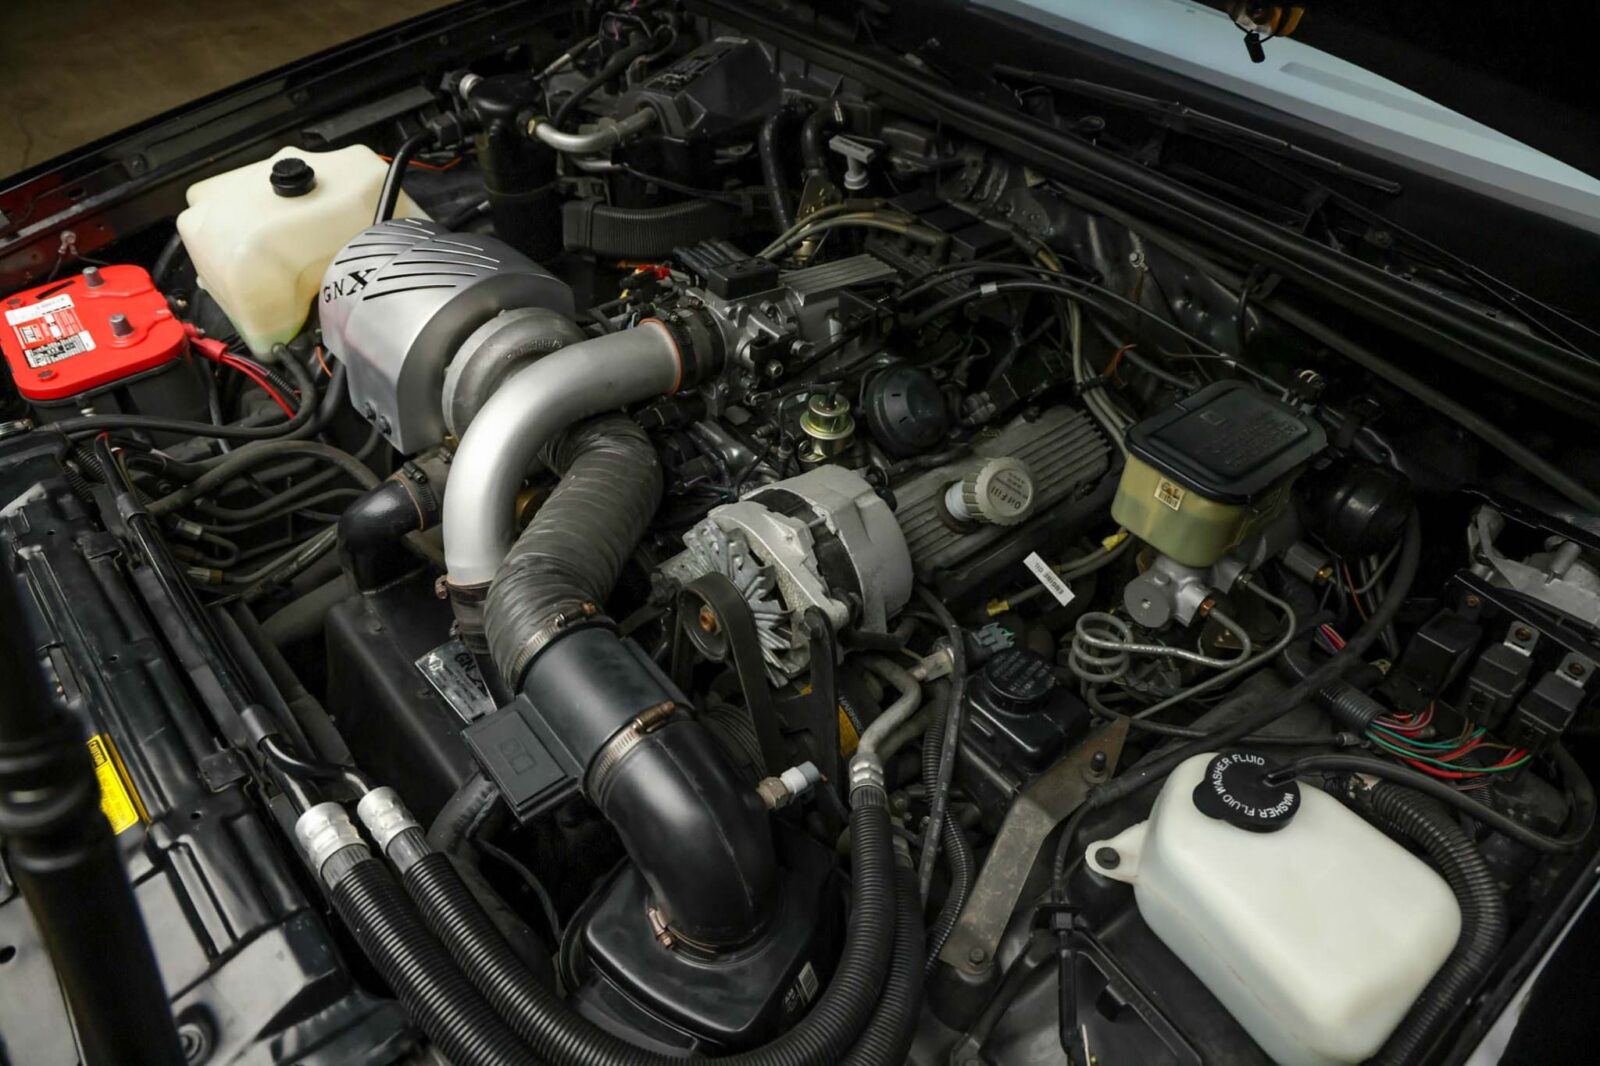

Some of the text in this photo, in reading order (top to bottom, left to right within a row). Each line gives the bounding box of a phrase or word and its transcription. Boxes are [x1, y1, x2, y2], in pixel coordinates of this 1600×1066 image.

[323, 267, 377, 303] GNX
[1034, 562, 1065, 595] ENGINE OIL
[1212, 753, 1265, 795] WASHER FLUID
[1222, 792, 1295, 818] WASHER FLUID
